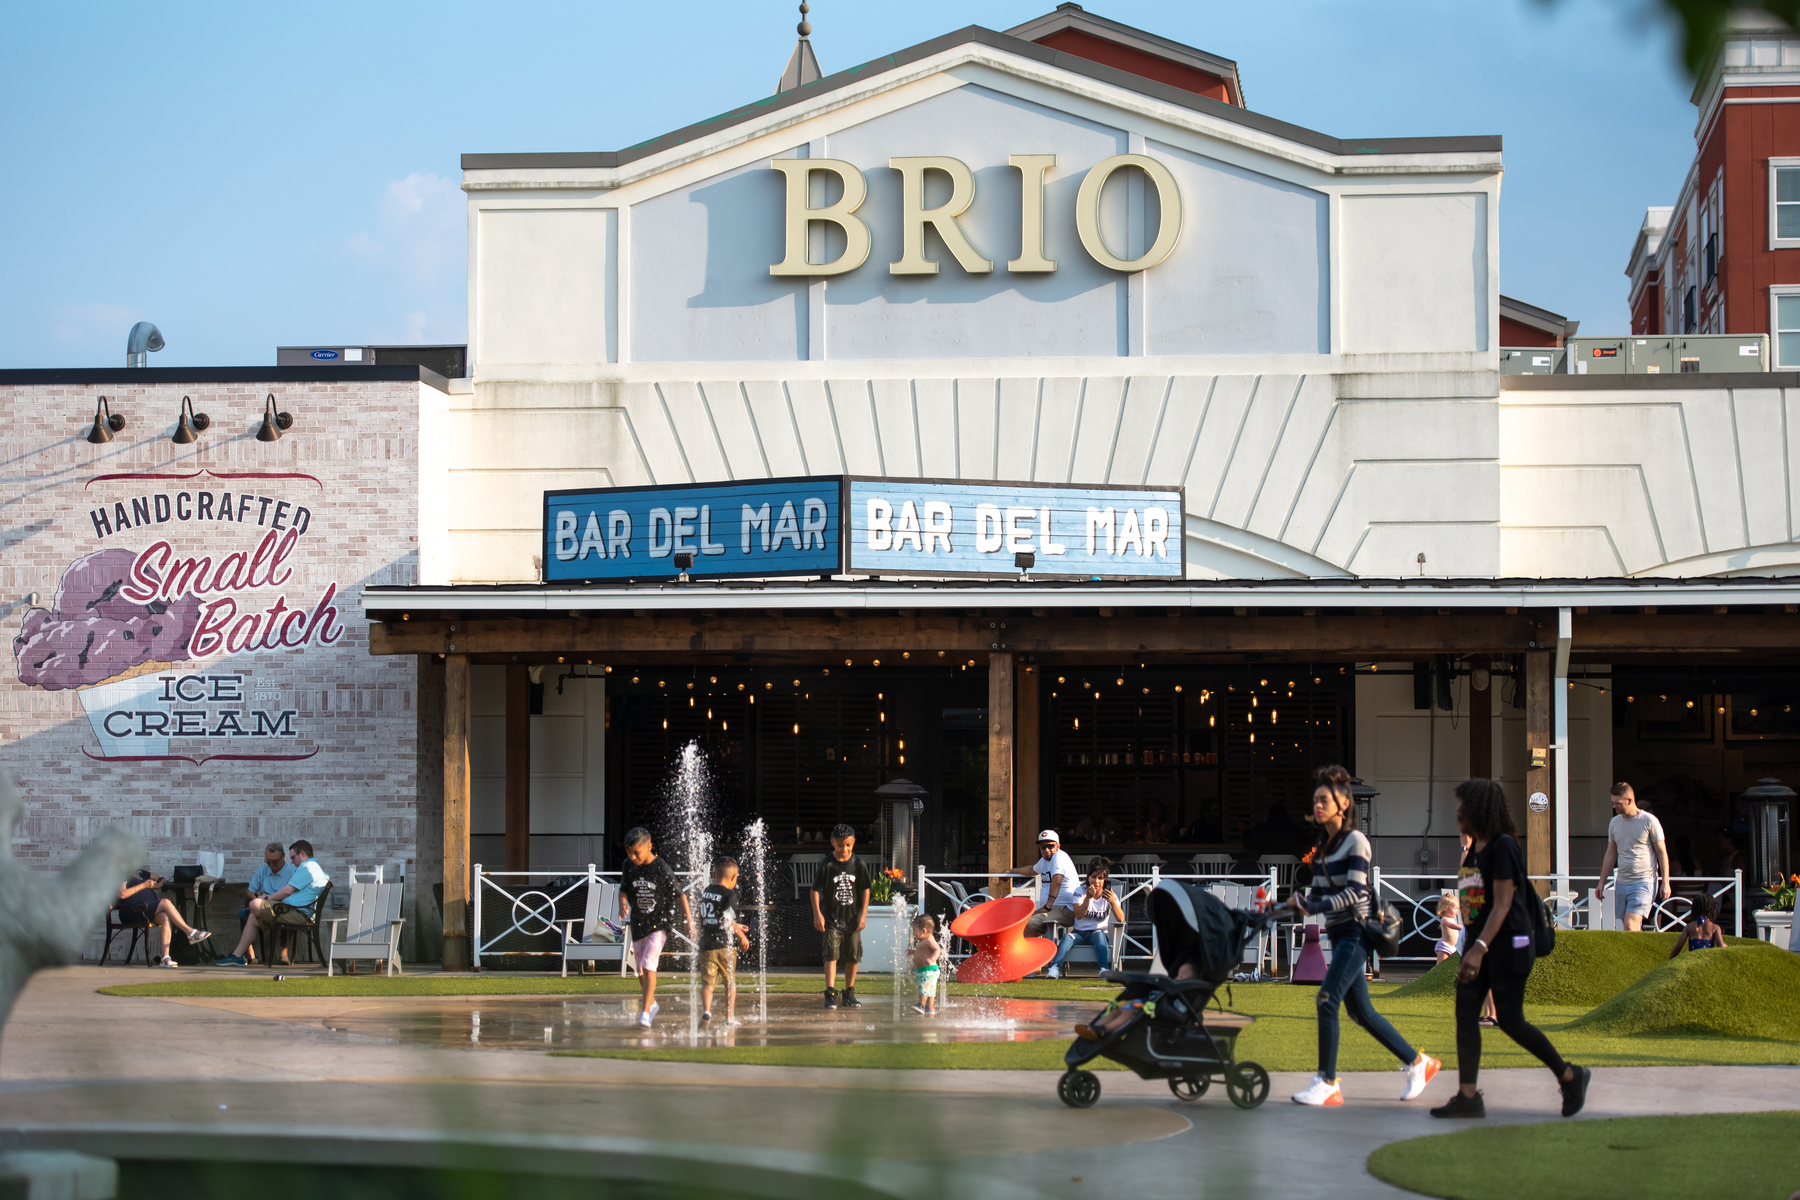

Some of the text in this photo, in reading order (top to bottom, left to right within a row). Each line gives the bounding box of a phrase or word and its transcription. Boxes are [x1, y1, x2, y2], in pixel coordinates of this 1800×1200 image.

[769, 153, 1185, 276] BRIO
[90, 491, 312, 539] HANDCRAFTED
[555, 497, 829, 561] BAR DEL MAR
[866, 498, 1170, 560] BAR DEL MAR
[121, 526, 293, 601] Small
[188, 582, 343, 657] Batch
[158, 675, 242, 702] ICE
[254, 691, 281, 701] 1870
[256, 677, 279, 687] Est.
[103, 710, 297, 737] CREAM
[700, 902, 715, 918] 02
